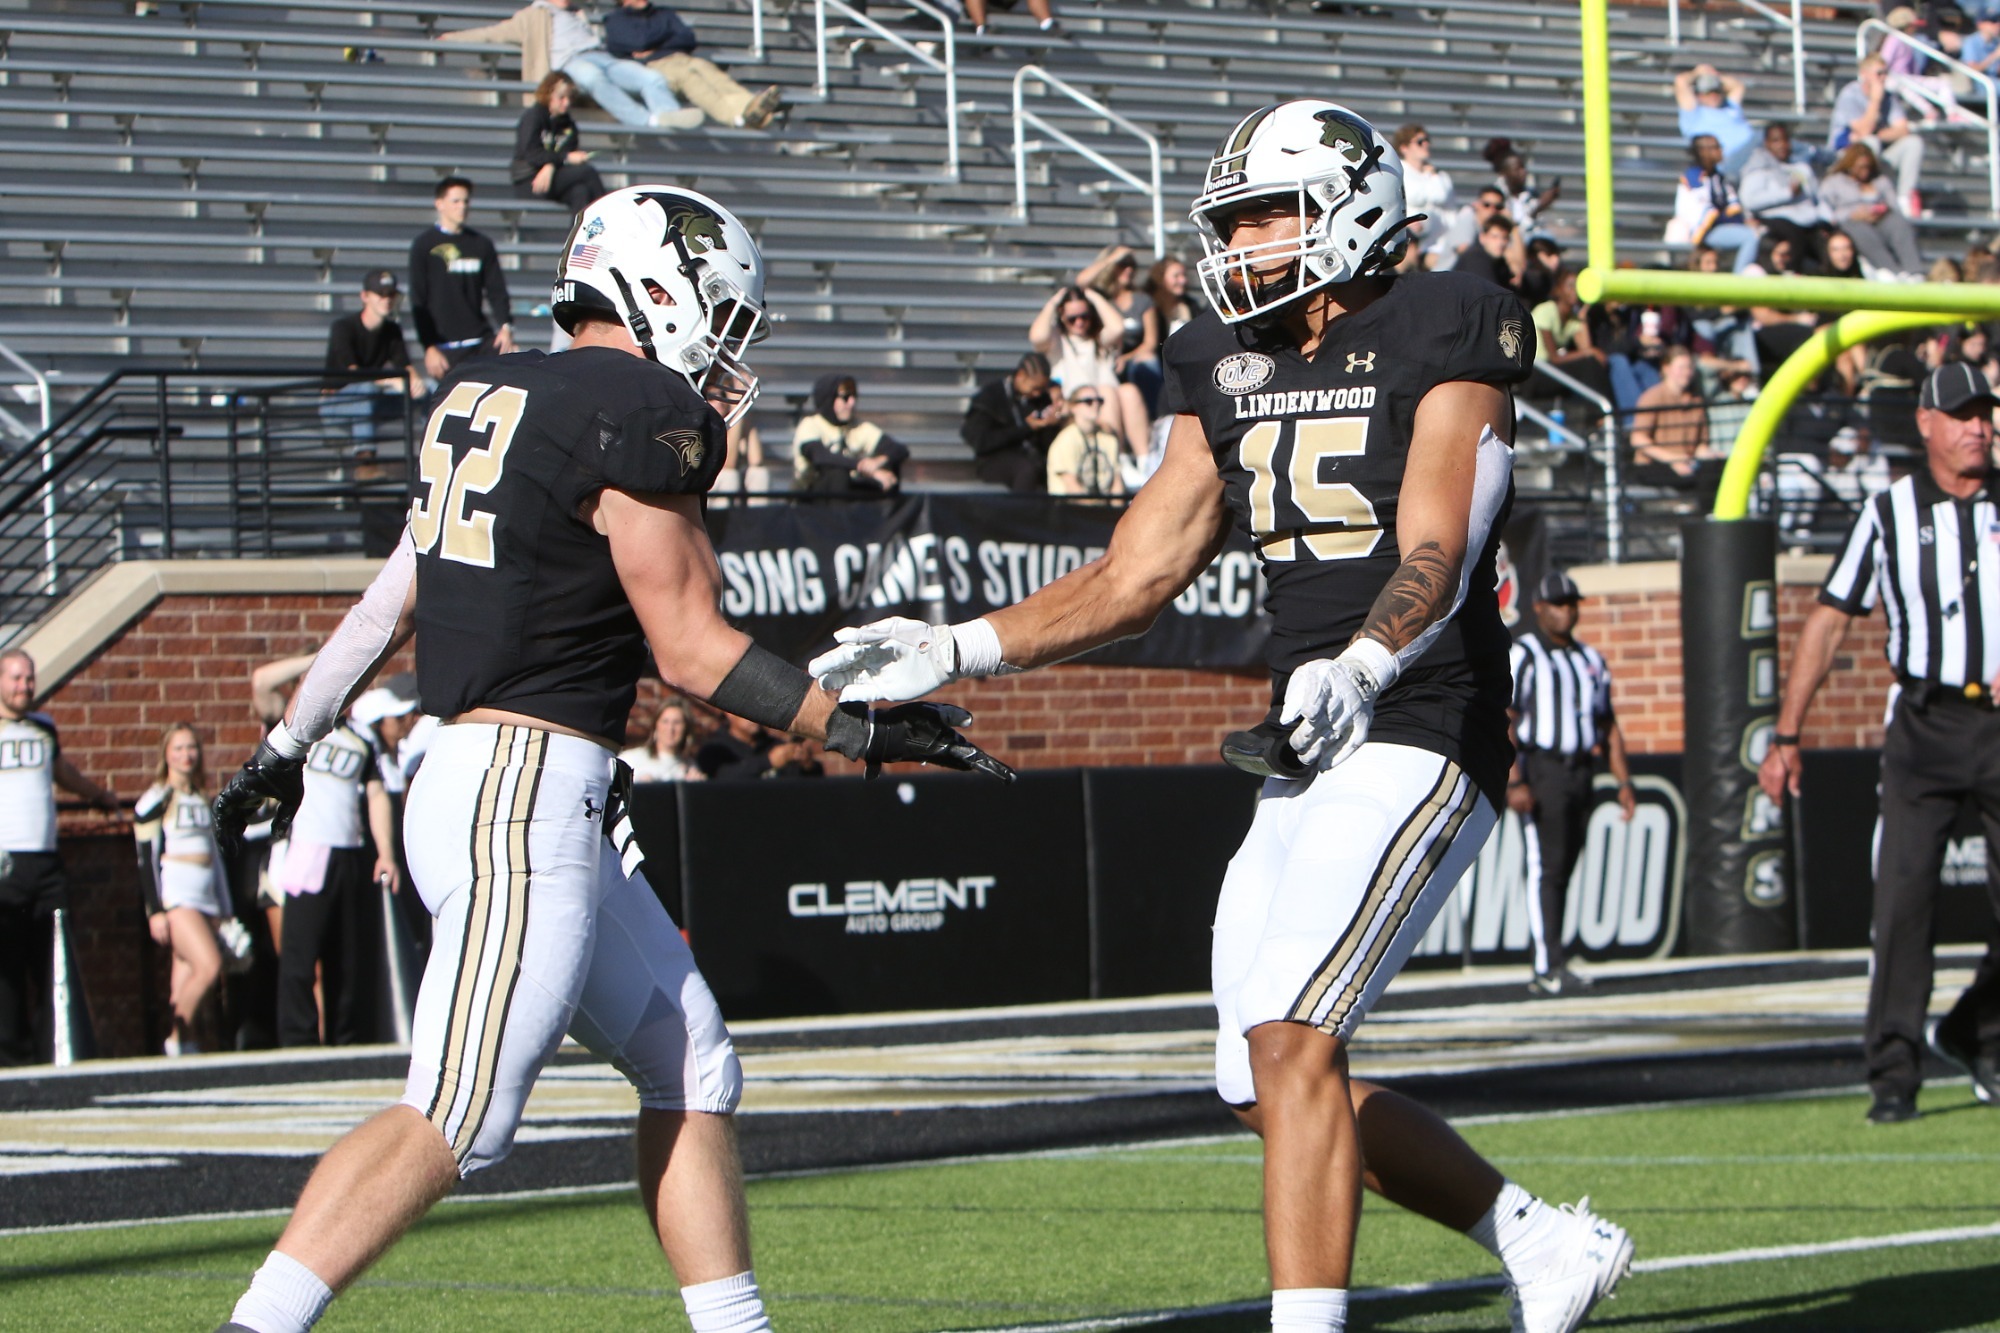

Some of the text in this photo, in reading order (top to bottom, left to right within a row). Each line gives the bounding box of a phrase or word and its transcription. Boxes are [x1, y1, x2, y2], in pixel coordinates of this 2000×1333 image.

[1224, 364, 1261, 383] OVC
[1235, 386, 1377, 419] LINDENWOOD
[410, 381, 528, 569] 52
[1239, 416, 1384, 561] 15
[717, 547, 826, 617] SING
[0, 740, 44, 769] LU
[308, 742, 363, 780] LU
[788, 876, 995, 916] CLEMENT
[845, 911, 944, 933] AUTO GROUP
